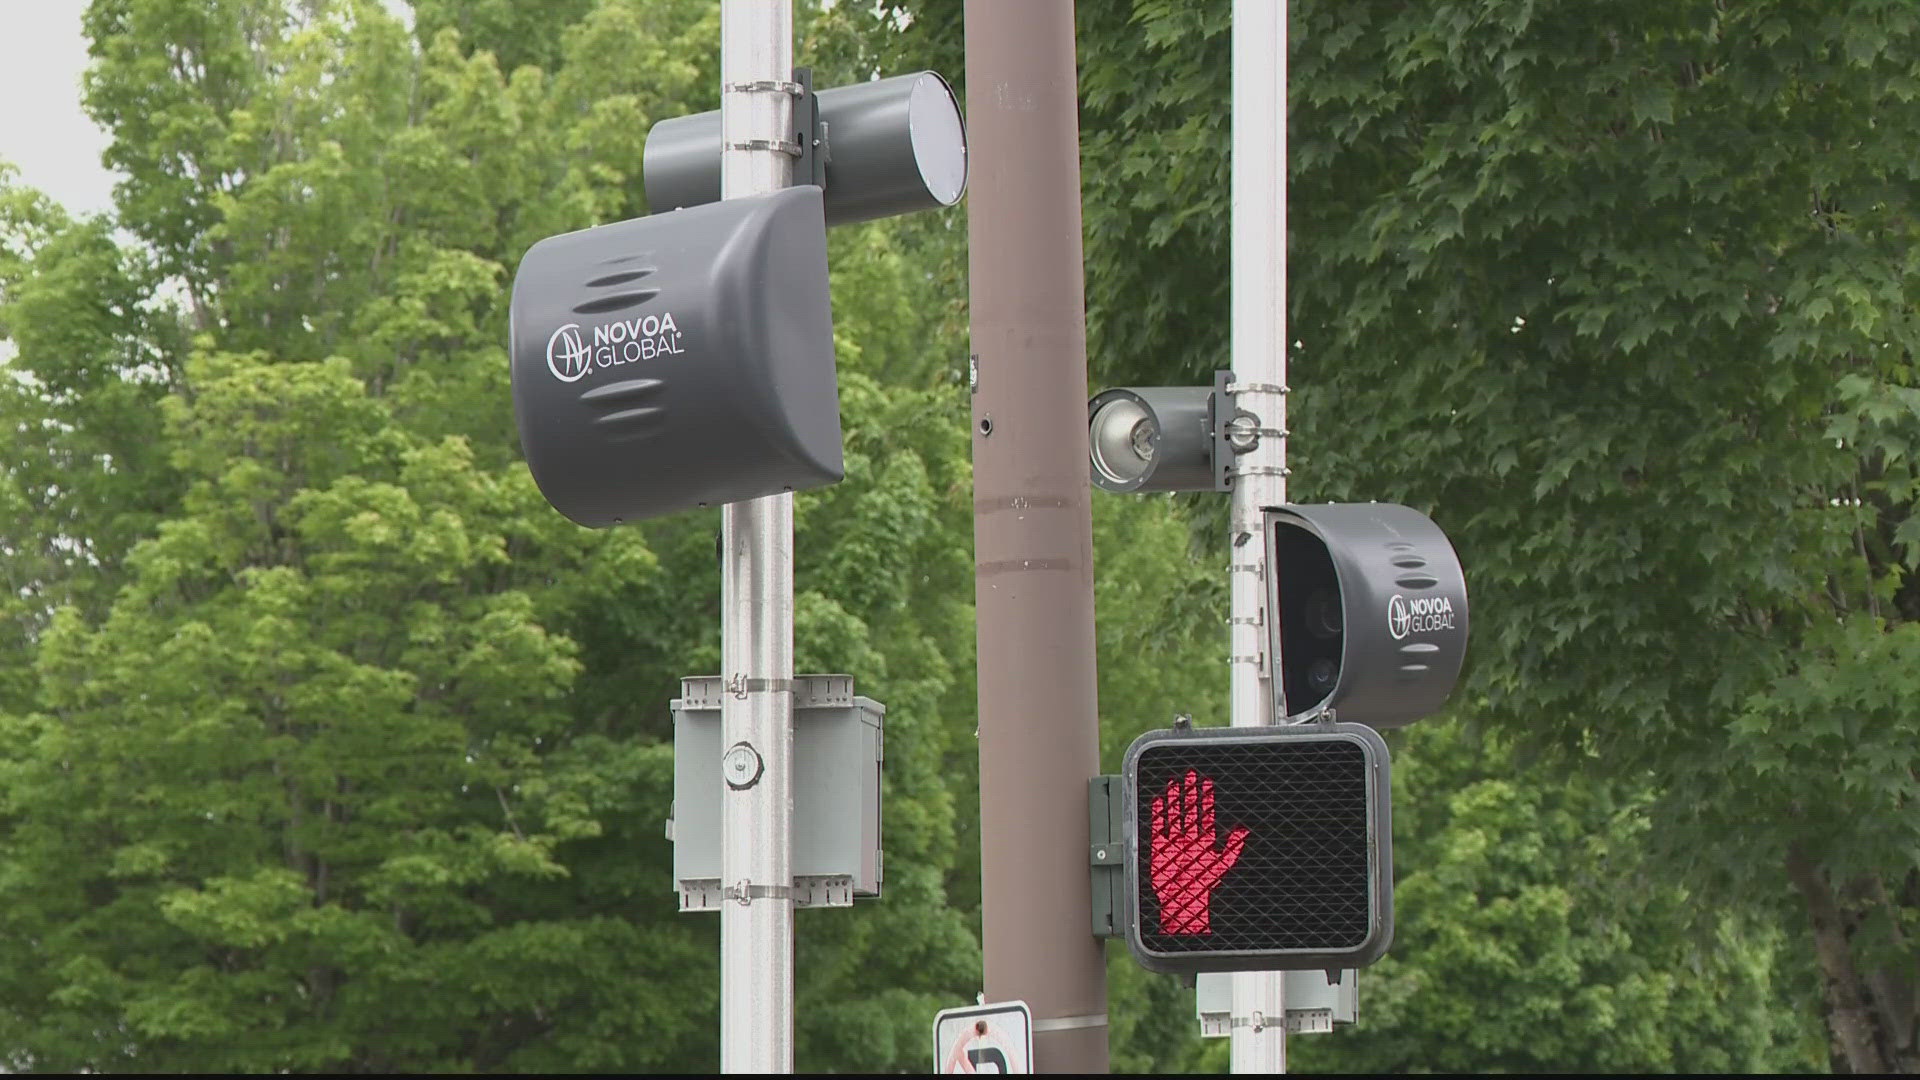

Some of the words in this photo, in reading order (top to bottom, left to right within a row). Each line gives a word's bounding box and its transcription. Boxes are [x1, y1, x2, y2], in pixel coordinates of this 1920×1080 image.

[594, 312, 677, 347] NOVOA
[595, 333, 685, 368] GLOBAL
[1410, 597, 1452, 615] NOVOA
[1411, 614, 1455, 632] GLOBAL
